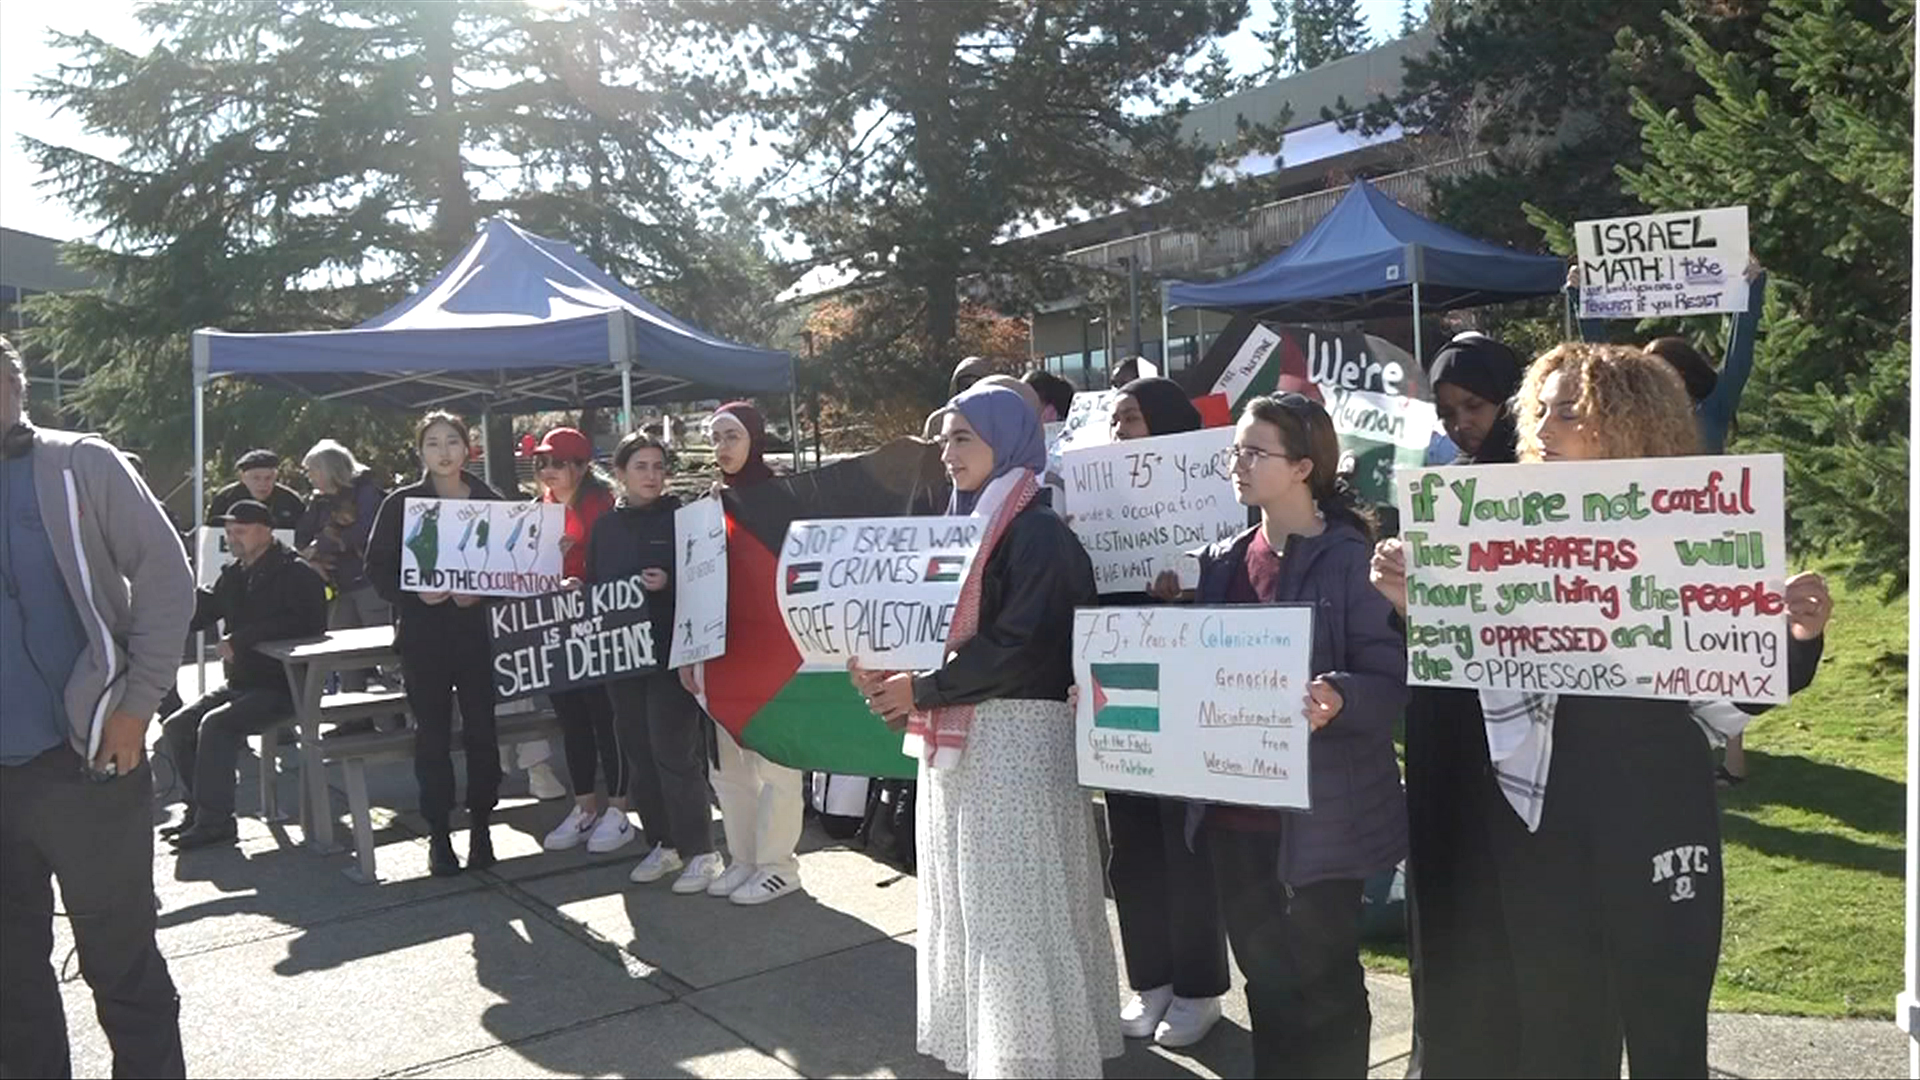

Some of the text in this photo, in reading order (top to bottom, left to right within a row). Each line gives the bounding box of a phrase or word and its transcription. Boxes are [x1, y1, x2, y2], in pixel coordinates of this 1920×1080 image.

[1592, 216, 1717, 256] ISRAEL
[1583, 257, 1664, 285] MATH:
[1308, 332, 1404, 395] We're
[1072, 461, 1115, 493] WITH
[1583, 482, 1650, 522] not
[788, 524, 978, 558] STOP ISRAEL WAR
[1078, 526, 1169, 552] ALESTINIANS
[1466, 535, 1639, 572] NEWSPAPERS
[1674, 530, 1765, 569] will
[404, 568, 561, 593] END THE OCCUPATION
[828, 555, 919, 588] CRIMES
[491, 575, 645, 639] KILLING KIDS
[1494, 580, 1552, 616] you
[1626, 575, 1679, 611] the
[543, 616, 603, 646] IS NOT
[787, 599, 957, 655] FREE PALESTINE
[1171, 622, 1189, 648] of
[1199, 615, 1291, 649] Colonization
[1406, 615, 1475, 661] being
[1480, 625, 1608, 658] OPPRESSED
[1611, 615, 1673, 650] and
[494, 621, 657, 697] SELF DEFENSE
[1411, 651, 1454, 682] the
[1463, 659, 1627, 690] OPPRESSORS
[1215, 667, 1289, 690] Genocide
[1199, 700, 1293, 726] Misinformation
[1111, 734, 1125, 748] the
[1261, 731, 1290, 751] from
[1252, 757, 1288, 777] Media
[1652, 845, 1709, 883] NYC
